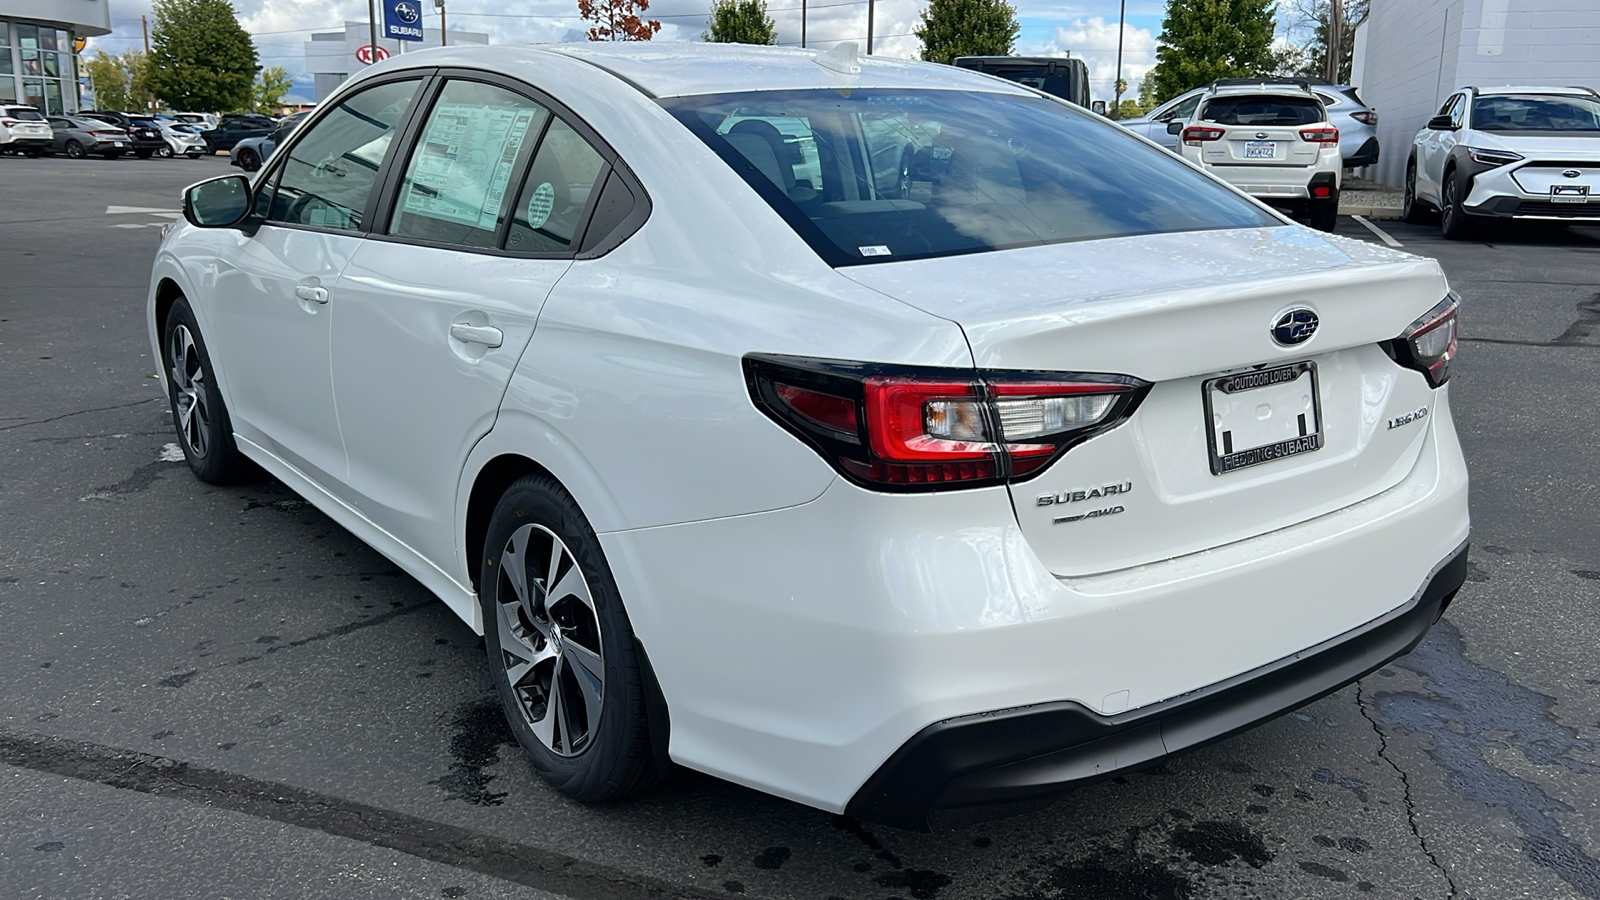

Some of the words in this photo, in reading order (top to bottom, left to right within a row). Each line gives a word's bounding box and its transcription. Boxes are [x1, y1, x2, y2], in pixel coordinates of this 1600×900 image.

[390, 25, 422, 37] SUBARU
[362, 50, 384, 61] KA
[1234, 373, 1270, 390] OUTDOOR
[1270, 369, 1292, 384] LOVER
[1387, 406, 1429, 430] LEGACY
[1224, 447, 1273, 470] REDDING
[1274, 436, 1316, 457] SUBARU
[1036, 481, 1132, 506] SUBARU
[1083, 505, 1125, 519] AWD
